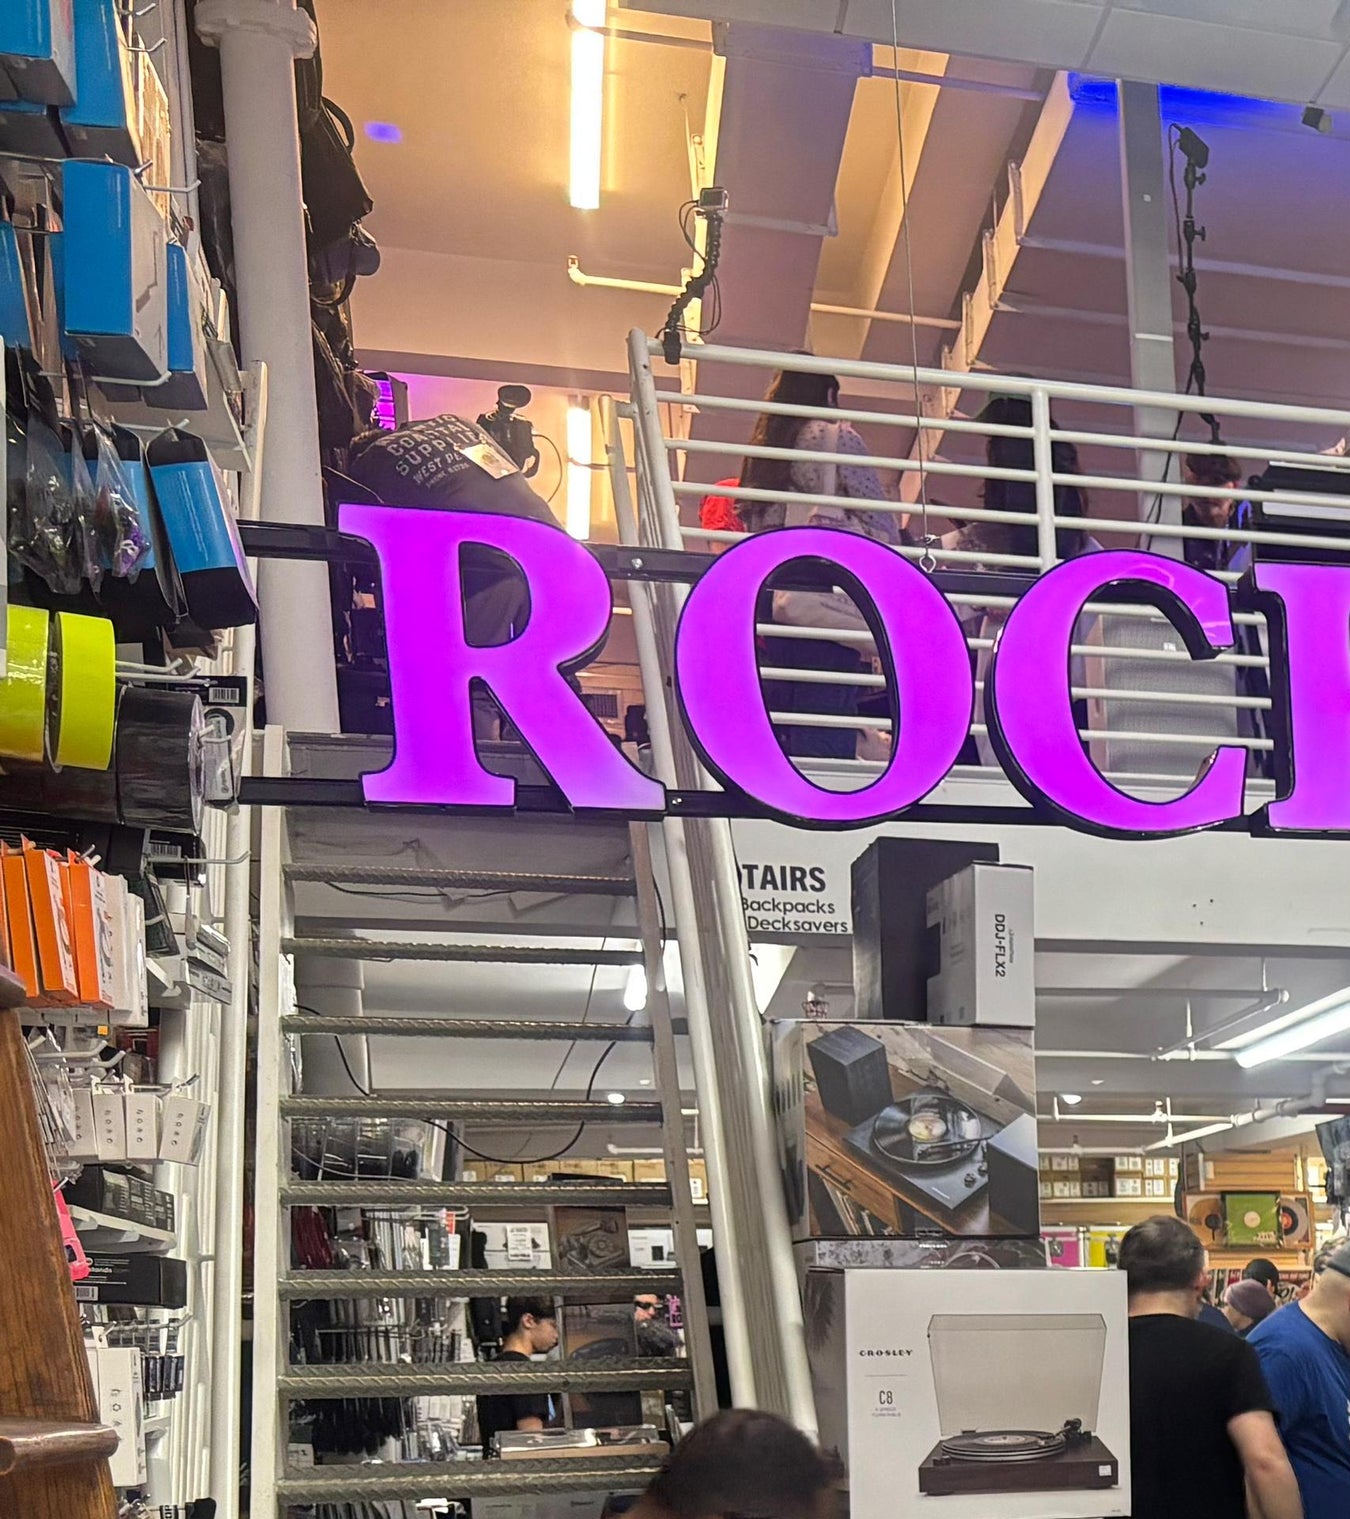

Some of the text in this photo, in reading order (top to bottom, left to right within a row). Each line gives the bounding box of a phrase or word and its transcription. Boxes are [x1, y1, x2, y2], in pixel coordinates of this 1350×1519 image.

[746, 916, 848, 933] Decksavers
[994, 913, 1007, 978] DDJ-FLX2
[859, 1349, 913, 1357] CROSLEY
[878, 1390, 893, 1405] C8
